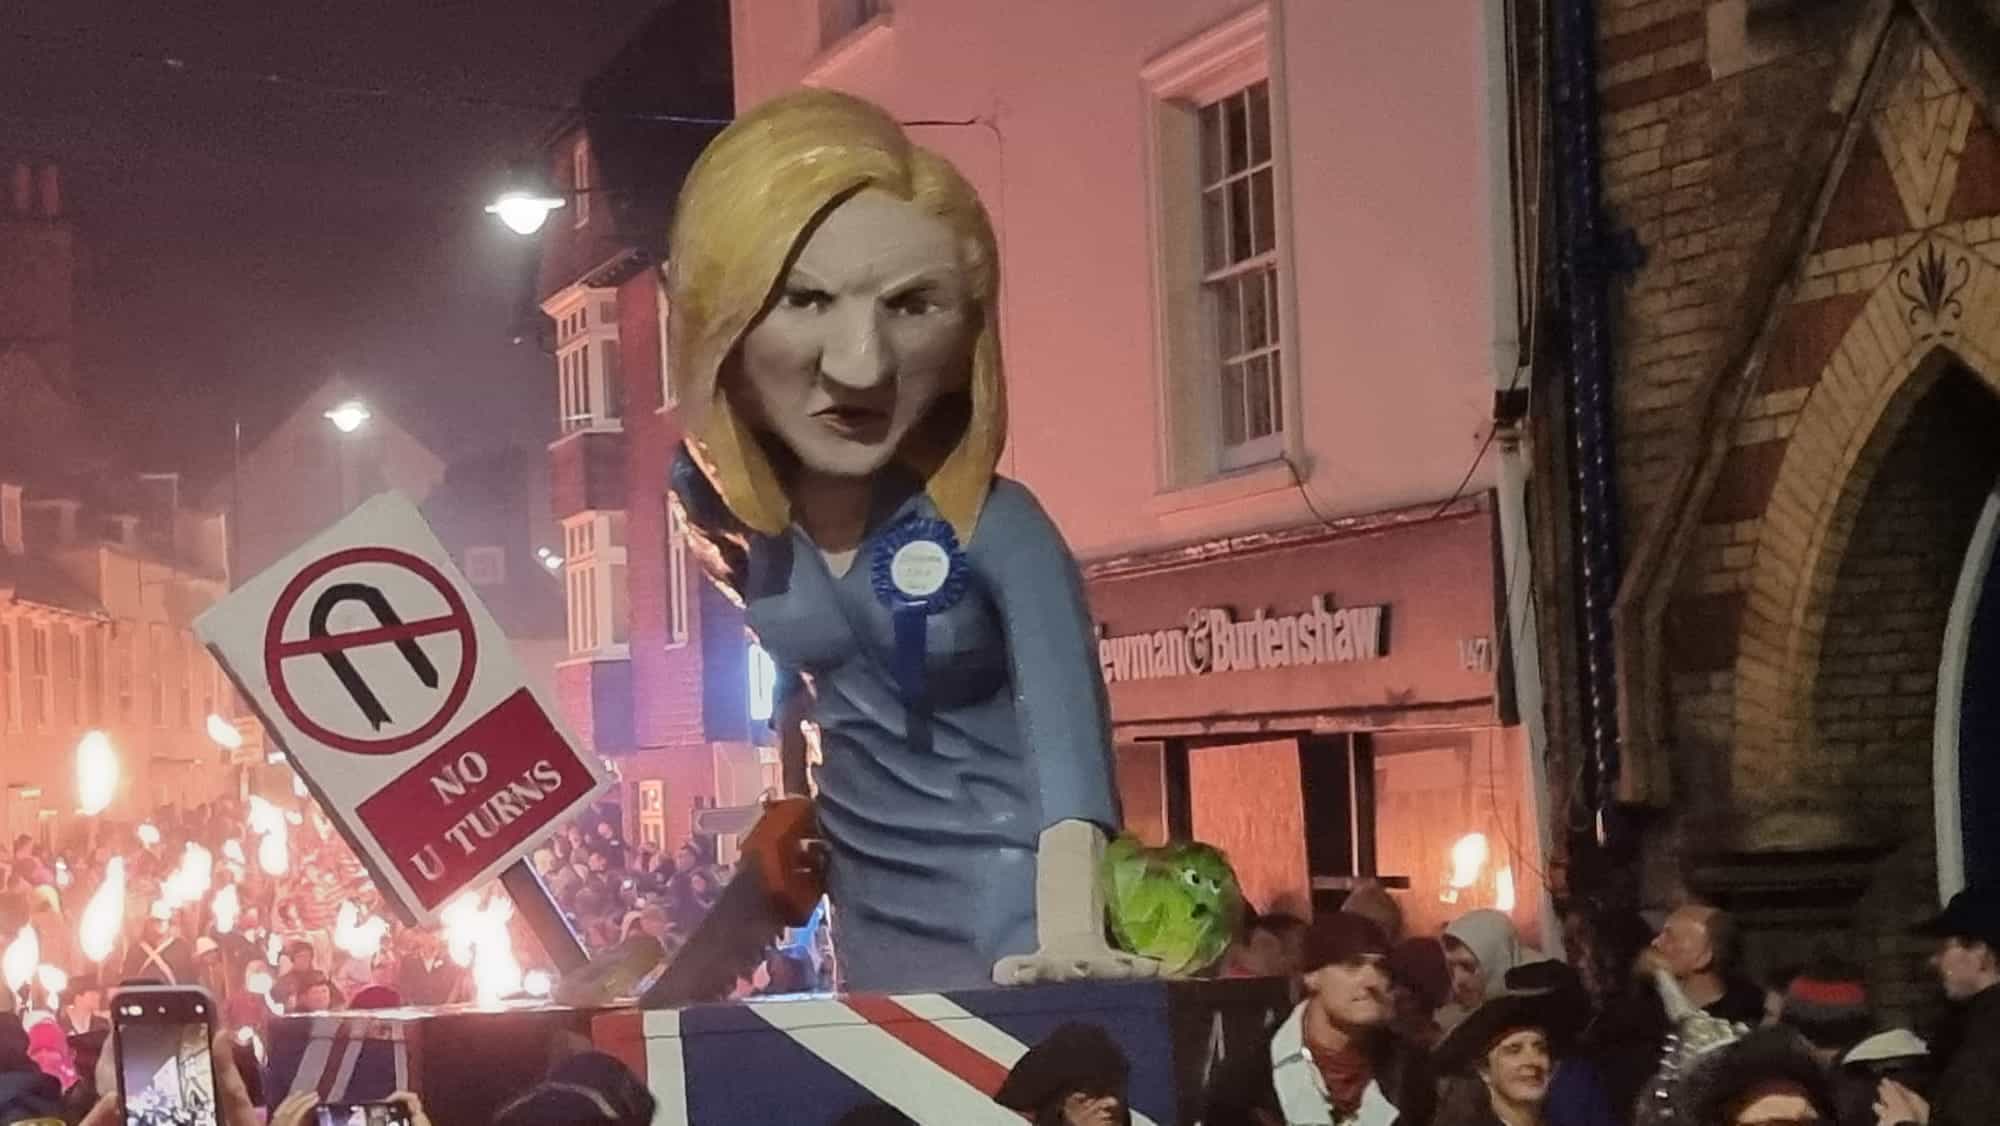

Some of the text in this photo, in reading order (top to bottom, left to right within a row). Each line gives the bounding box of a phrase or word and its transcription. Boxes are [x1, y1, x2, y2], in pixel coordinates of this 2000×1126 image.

[1095, 625, 1187, 684] ewman
[1208, 594, 1382, 673] Burtenshaw
[409, 759, 563, 882] U TURNS
[429, 750, 489, 806] NO
